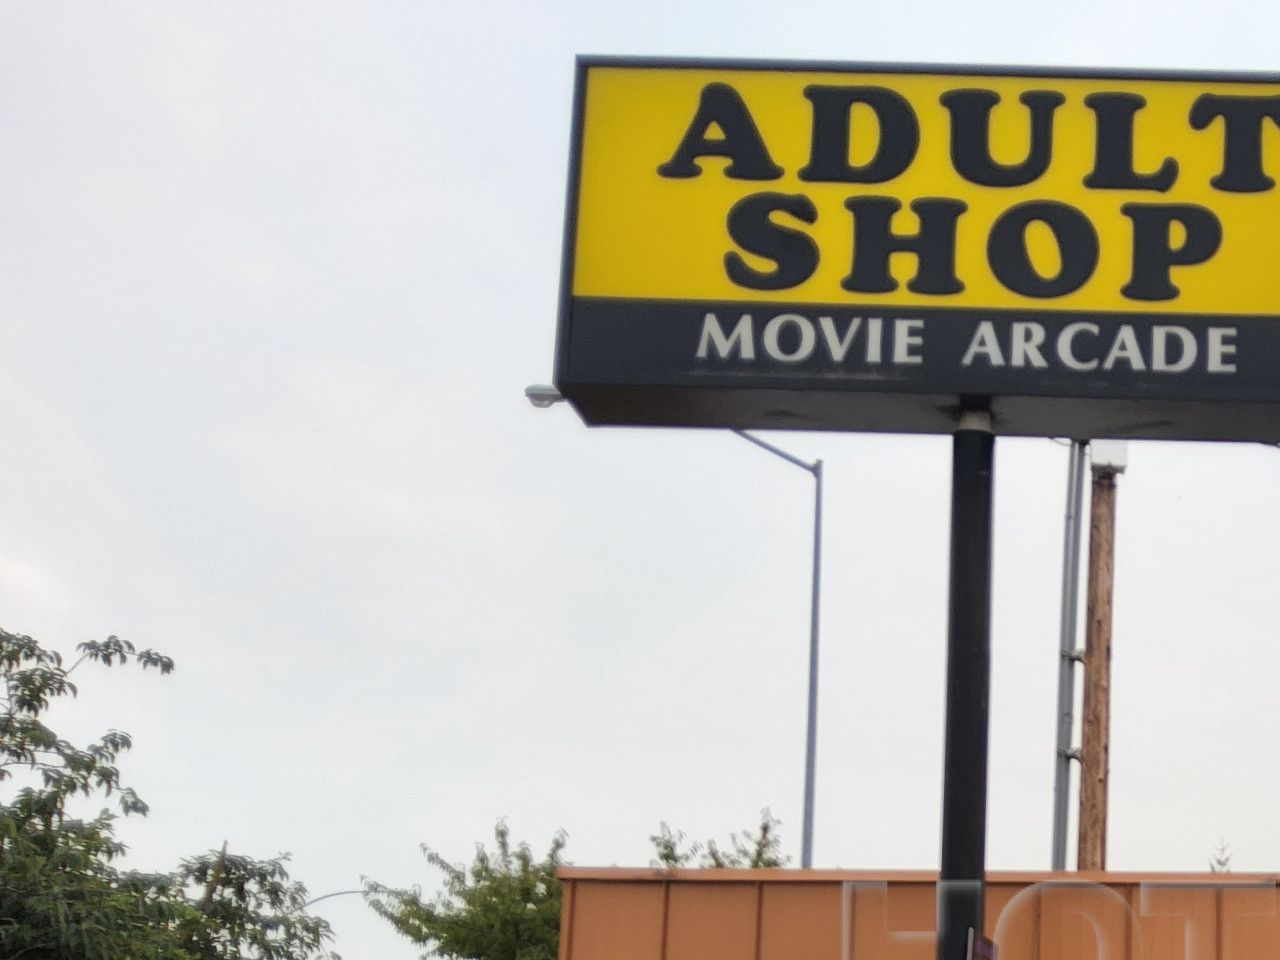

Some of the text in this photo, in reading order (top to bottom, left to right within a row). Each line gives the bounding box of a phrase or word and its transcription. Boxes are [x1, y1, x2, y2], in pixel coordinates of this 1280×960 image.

[723, 190, 1223, 301] SHOP
[695, 312, 1238, 374] MOVIE ARCADE
